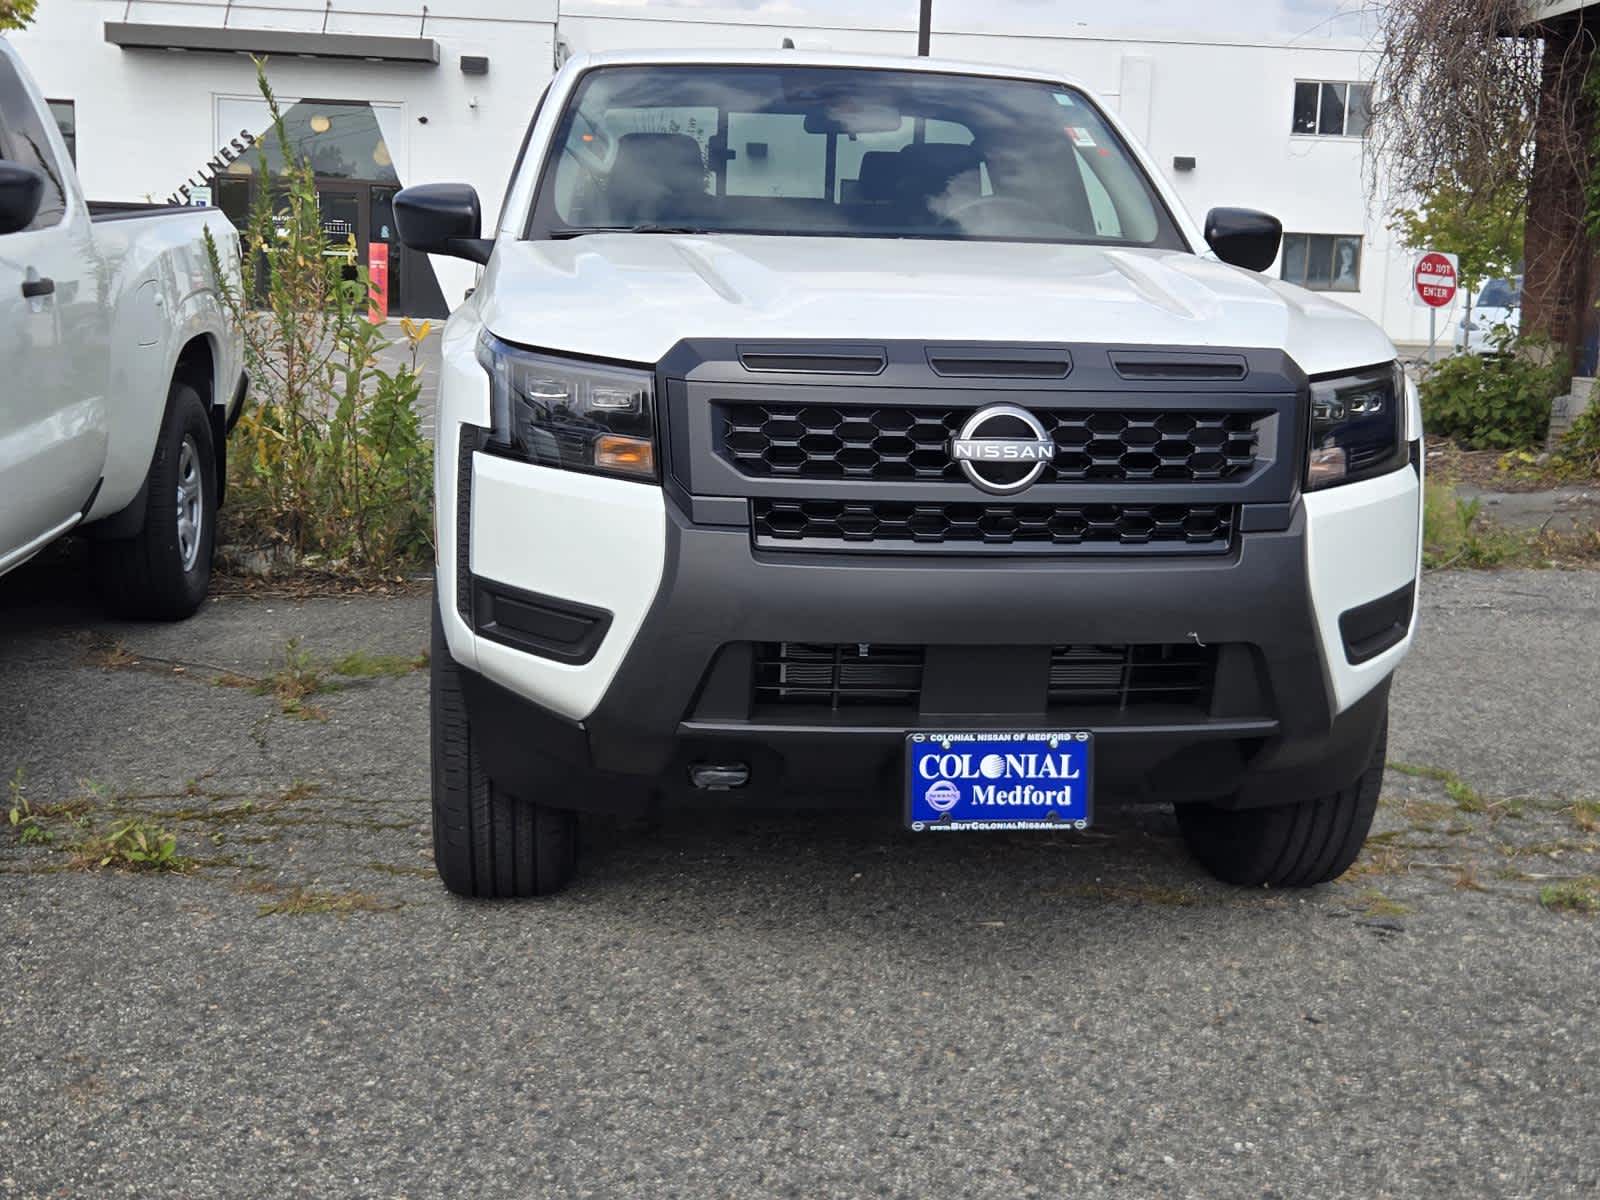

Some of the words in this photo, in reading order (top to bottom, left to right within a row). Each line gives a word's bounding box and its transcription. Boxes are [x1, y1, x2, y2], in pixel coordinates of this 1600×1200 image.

[1421, 262, 1432, 272] DO
[1435, 263, 1451, 274] NOT
[1423, 286, 1448, 298] ENTER
[956, 445, 1053, 458] NISSAN
[930, 734, 975, 742] COLONIAL
[1013, 733, 1024, 741] OF
[1027, 733, 1071, 741] MEDFORD
[919, 754, 1080, 779] COLONIAL
[971, 785, 1072, 806] Medford
